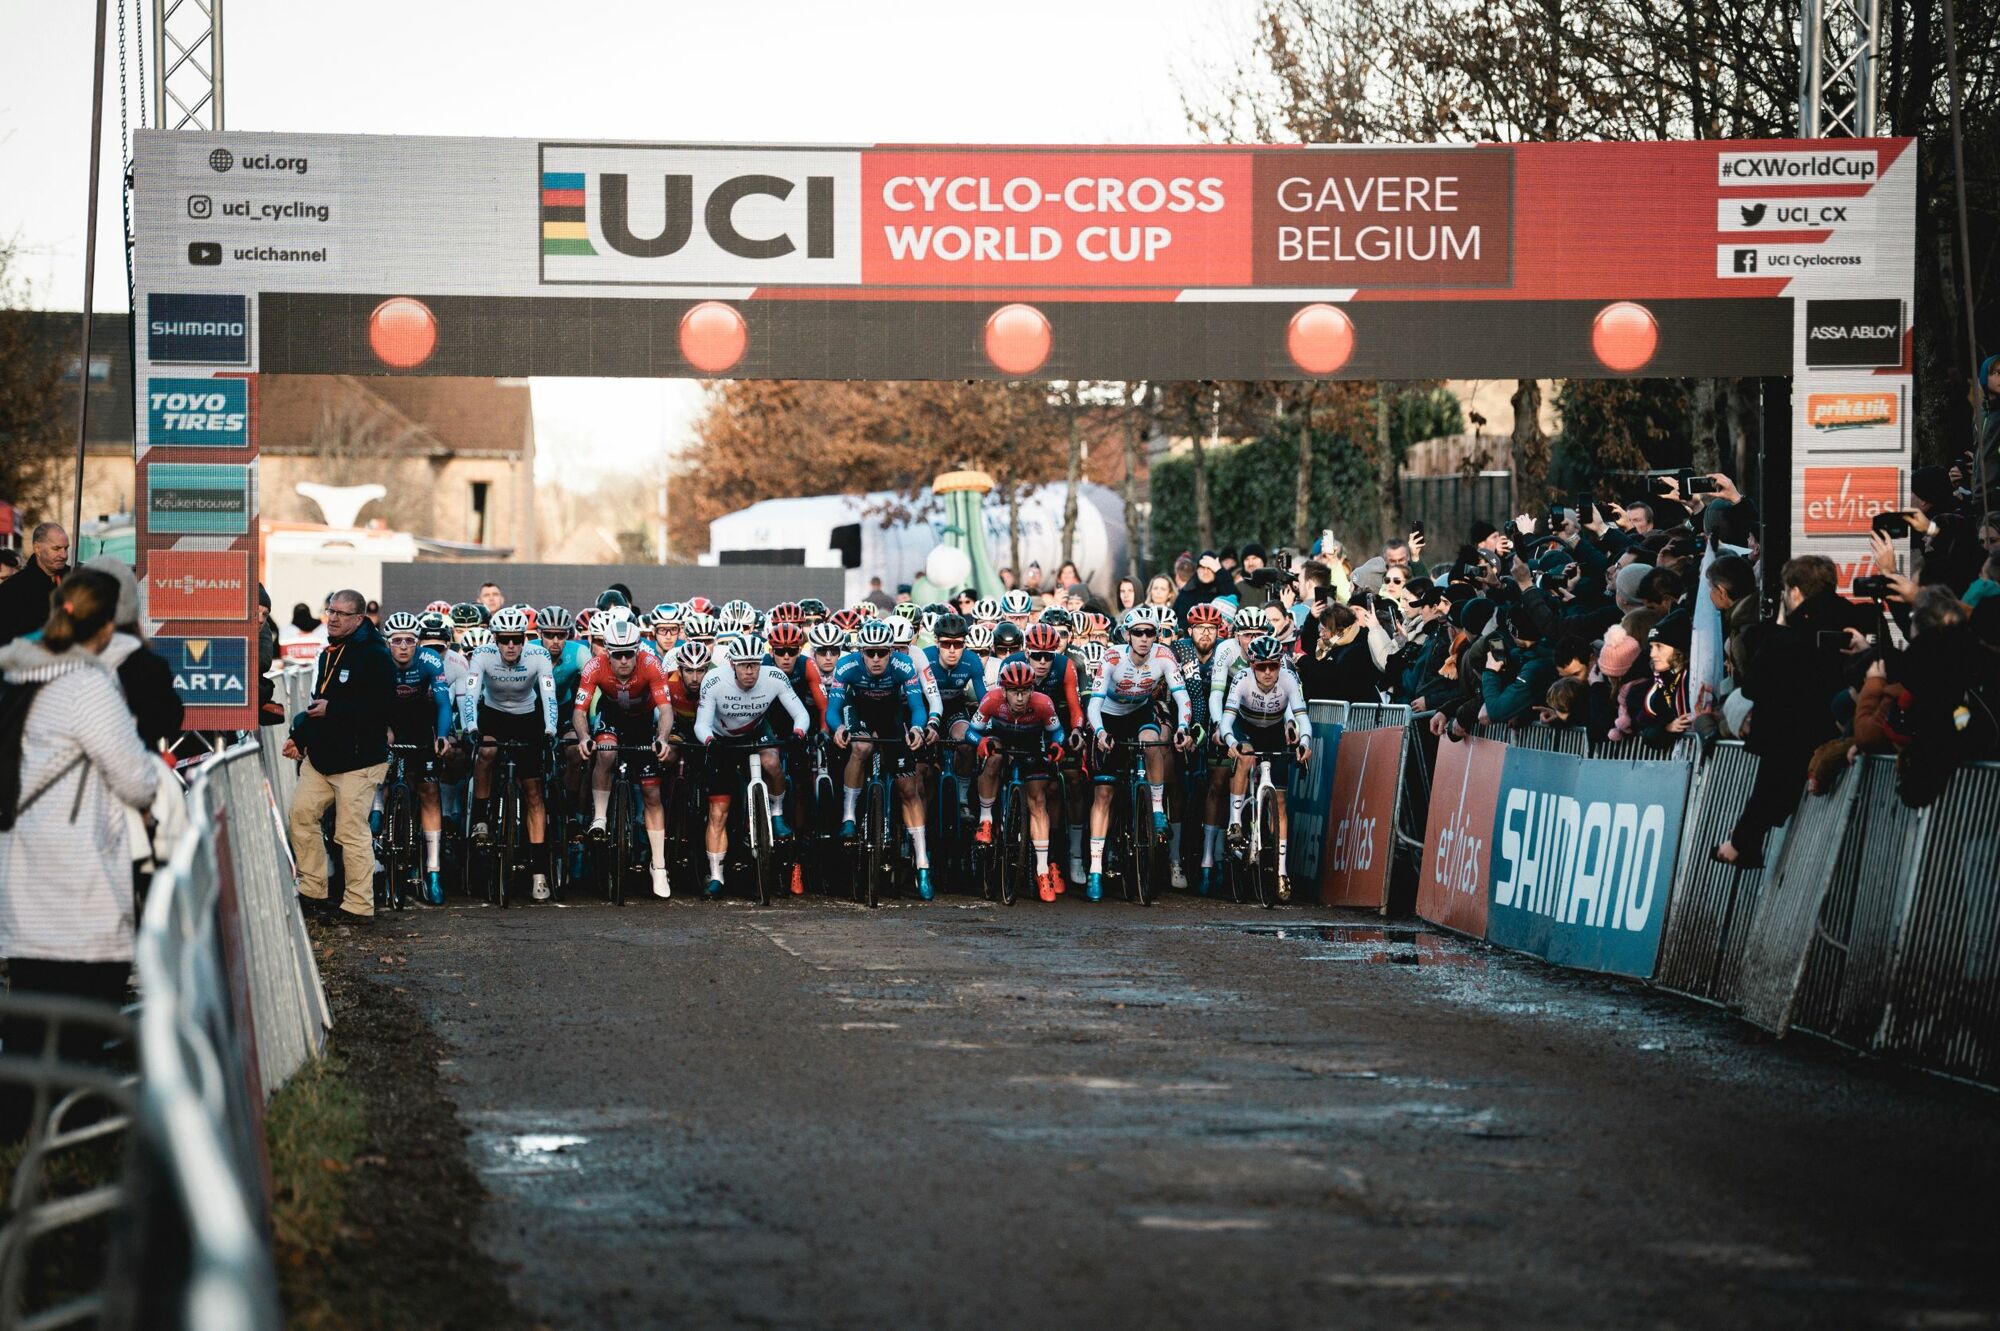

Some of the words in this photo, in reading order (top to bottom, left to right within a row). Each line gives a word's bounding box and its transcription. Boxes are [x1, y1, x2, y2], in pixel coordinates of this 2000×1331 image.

[242, 155, 308, 174] uci.org
[1721, 156, 1875, 180] #CXWorldCup
[882, 176, 1225, 213] CYCLO-CROSS
[1276, 176, 1459, 213] GAVERE
[222, 201, 330, 222] uci_cycling
[599, 173, 835, 259] UCI
[1777, 206, 1847, 226] UCI_CX
[884, 225, 1063, 261] WORLD
[1076, 226, 1172, 262] CUP
[1278, 225, 1481, 262] BELGIUM
[233, 246, 327, 263] ucichannel
[1767, 255, 1790, 266] UCI
[1793, 253, 1862, 268] Cyclocross
[151, 321, 244, 337] SHIMANO
[1810, 326, 1848, 340] ASSA
[1851, 325, 1897, 339] ABLOY
[150, 392, 226, 411] TOYO
[162, 413, 245, 432] TIRES
[1807, 473, 1894, 526] ethias
[172, 673, 244, 690] ARTA
[927, 686, 937, 694] 22
[1495, 787, 1666, 932] SHIMANO
